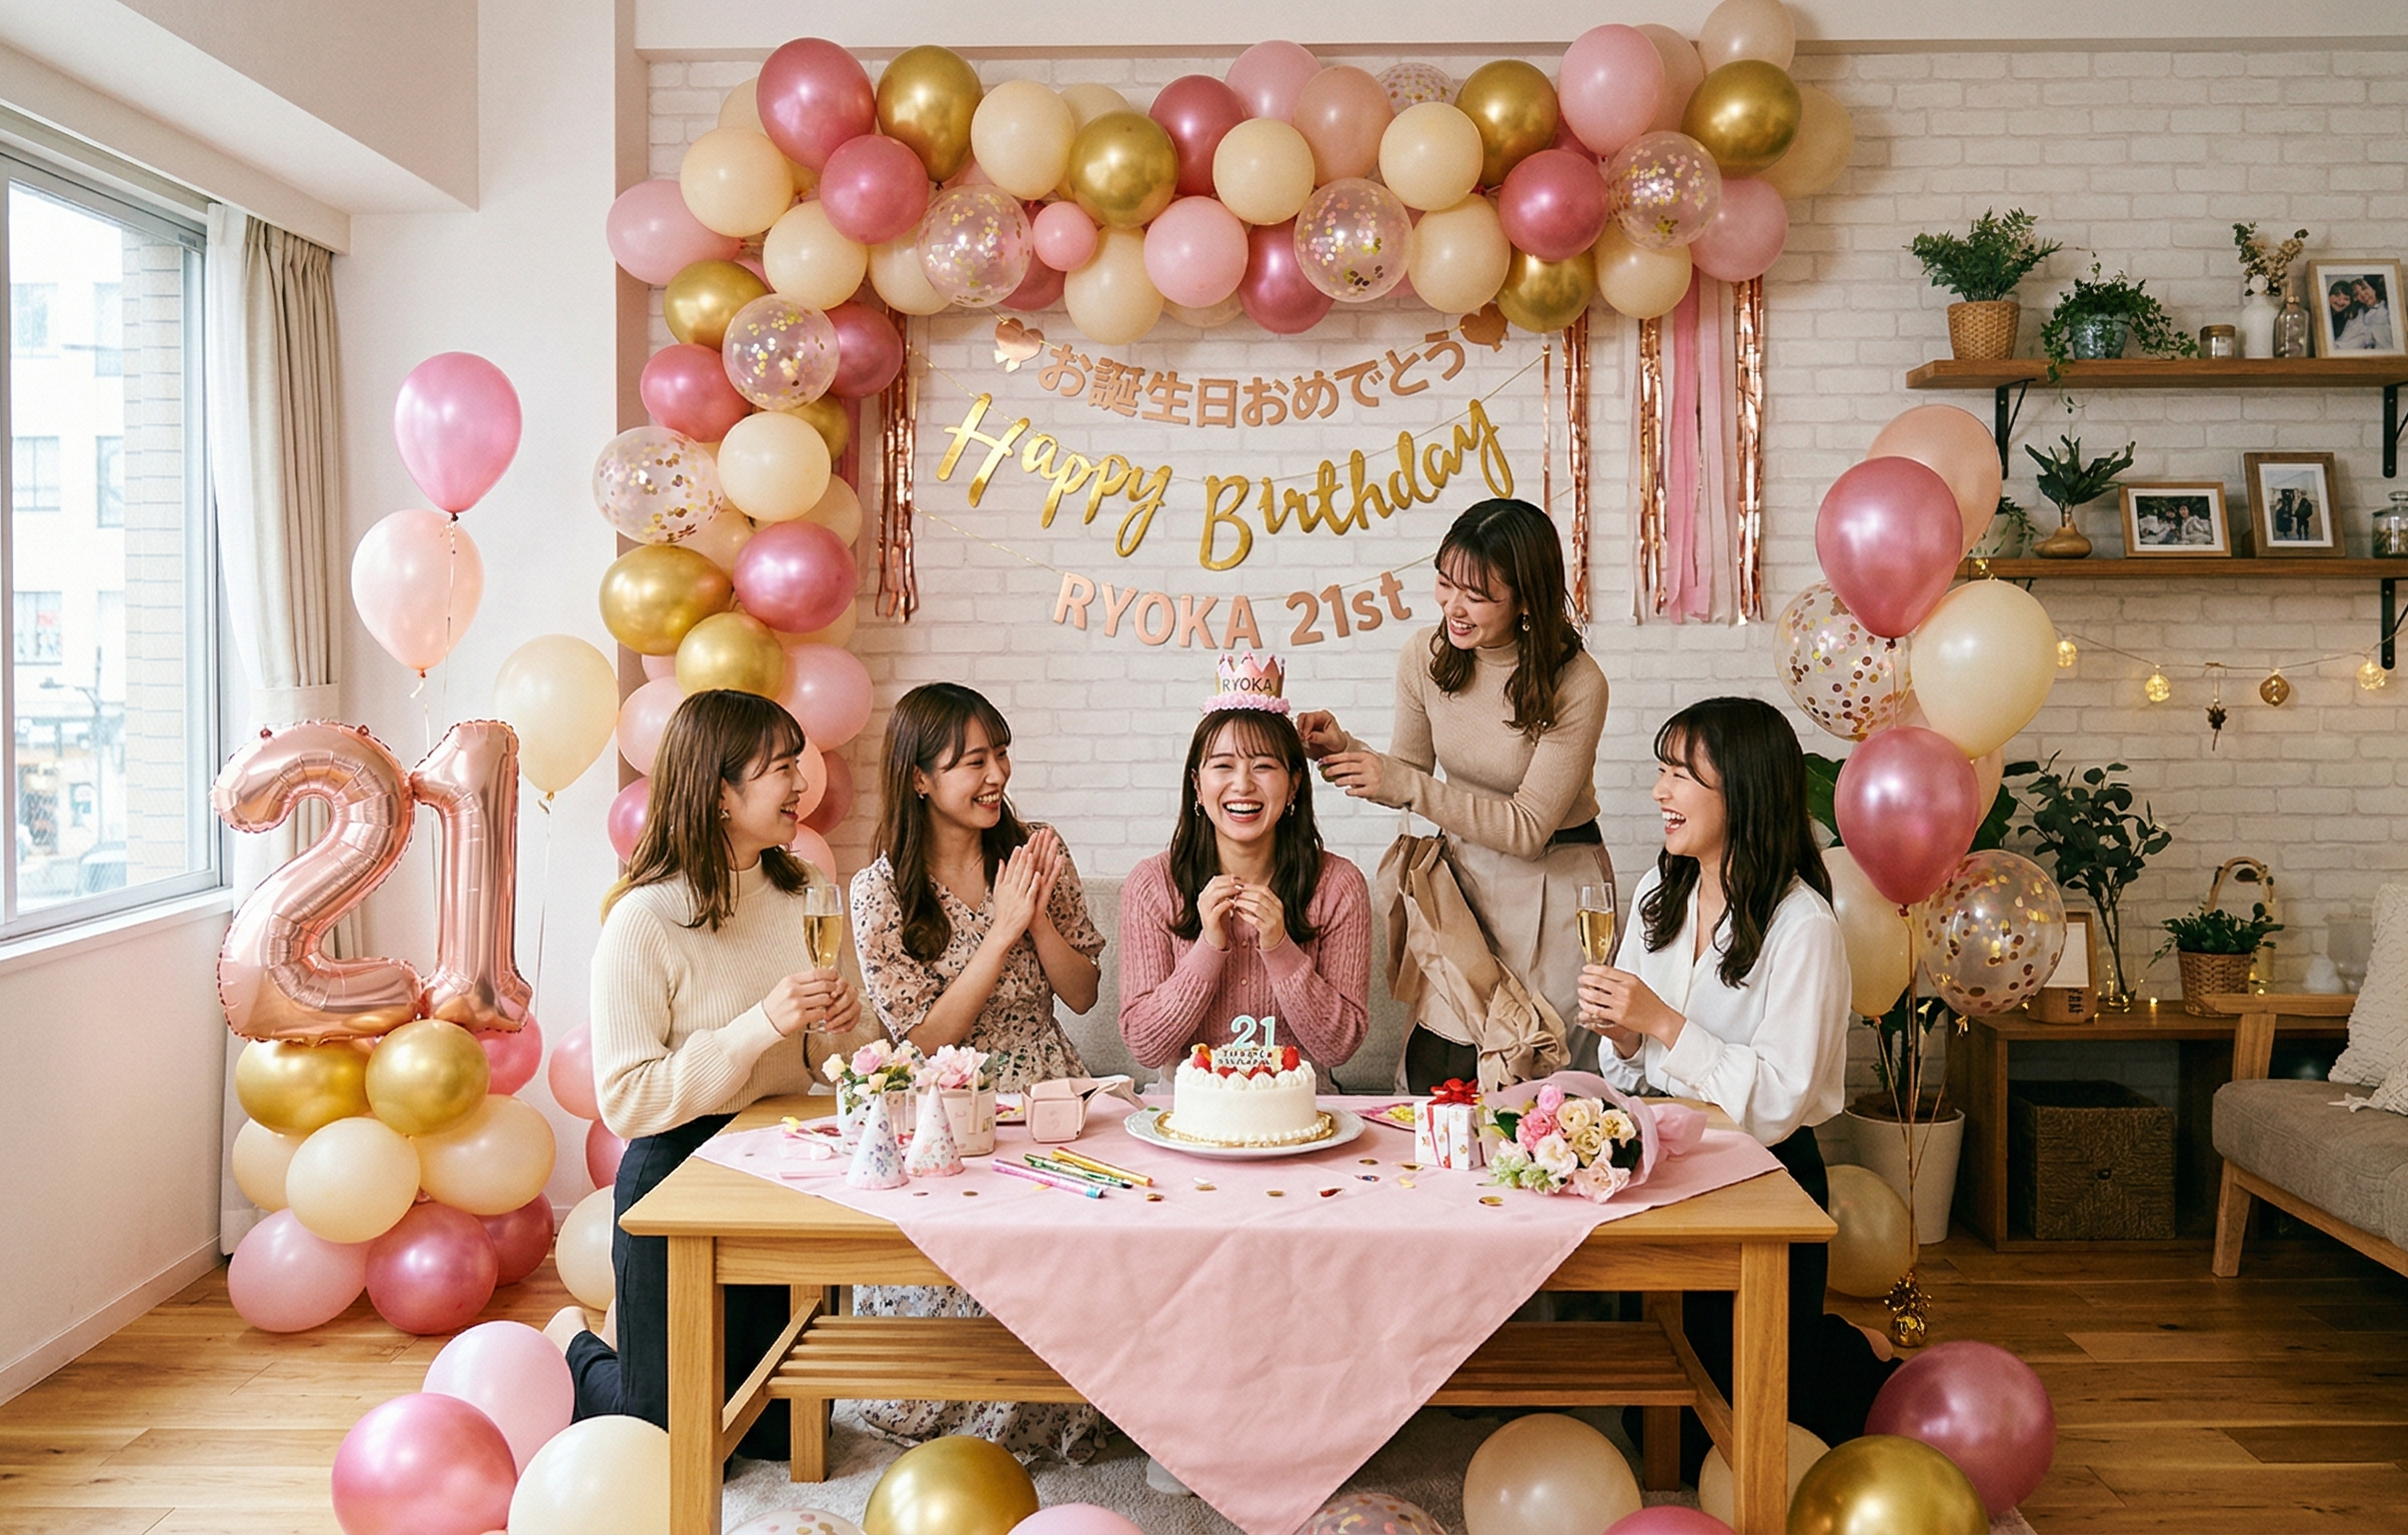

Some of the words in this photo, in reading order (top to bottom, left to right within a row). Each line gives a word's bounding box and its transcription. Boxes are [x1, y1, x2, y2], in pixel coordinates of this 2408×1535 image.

[1038, 331, 1466, 429] お誕生日おめでとう
[936, 393, 1173, 558] Happy
[1199, 399, 1514, 571] Birthday
[1053, 573, 1262, 650] RYOKA
[1285, 572, 1411, 648] 21st
[1221, 678, 1273, 693] RYOKA
[211, 719, 534, 1045] 21
[1229, 1014, 1276, 1049] 21
